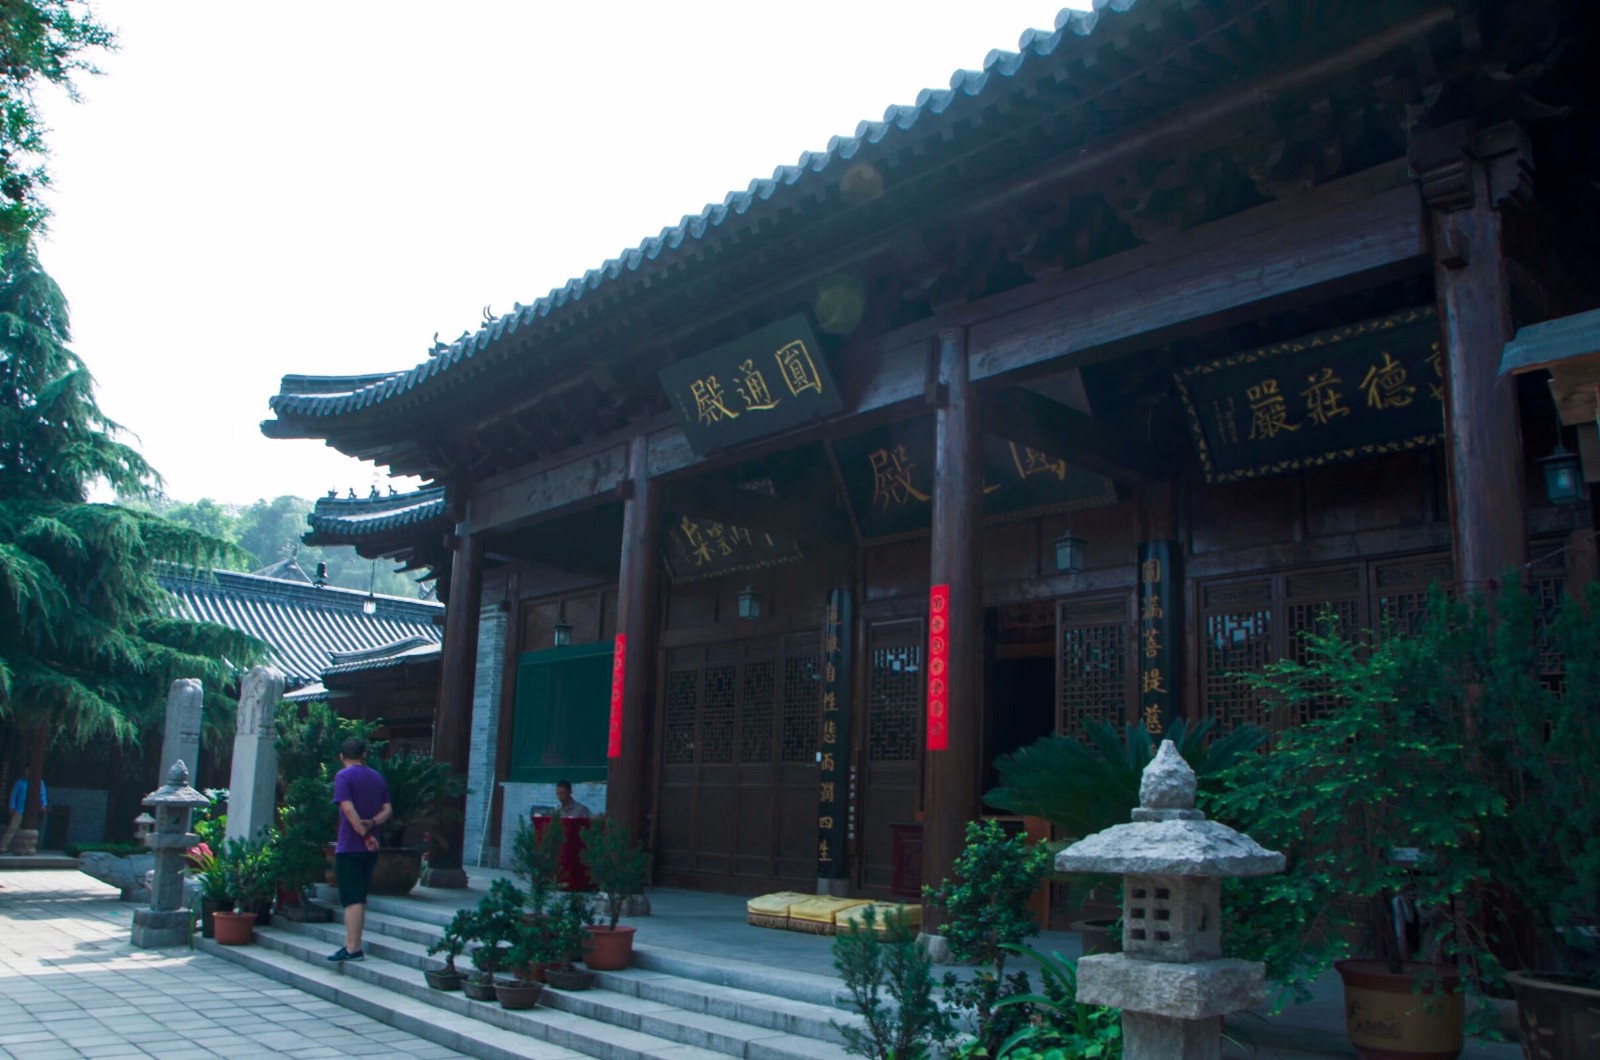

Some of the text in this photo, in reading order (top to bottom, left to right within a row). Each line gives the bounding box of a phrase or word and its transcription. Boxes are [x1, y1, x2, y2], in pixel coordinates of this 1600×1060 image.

[1141, 558, 1167, 756] 圓滿菩提慈
